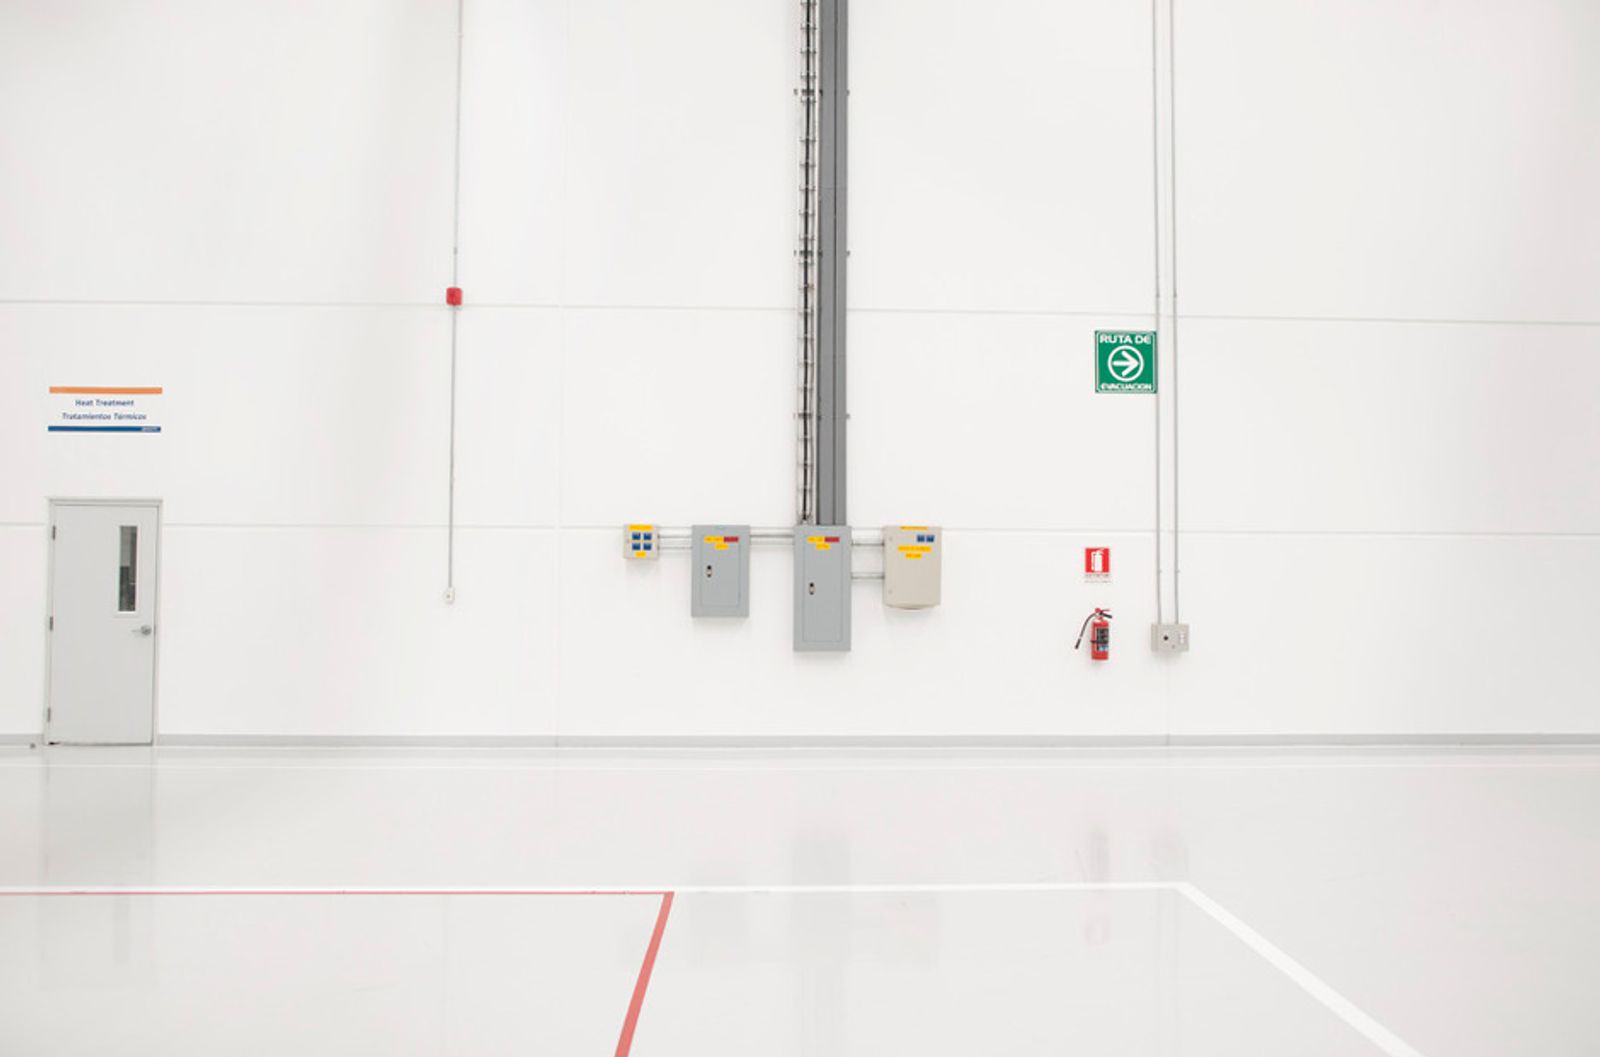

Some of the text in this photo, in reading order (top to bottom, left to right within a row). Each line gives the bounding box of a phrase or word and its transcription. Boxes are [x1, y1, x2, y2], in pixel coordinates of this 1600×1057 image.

[1099, 335, 1152, 344] RUTA DE
[62, 412, 112, 420] Tratamientos
